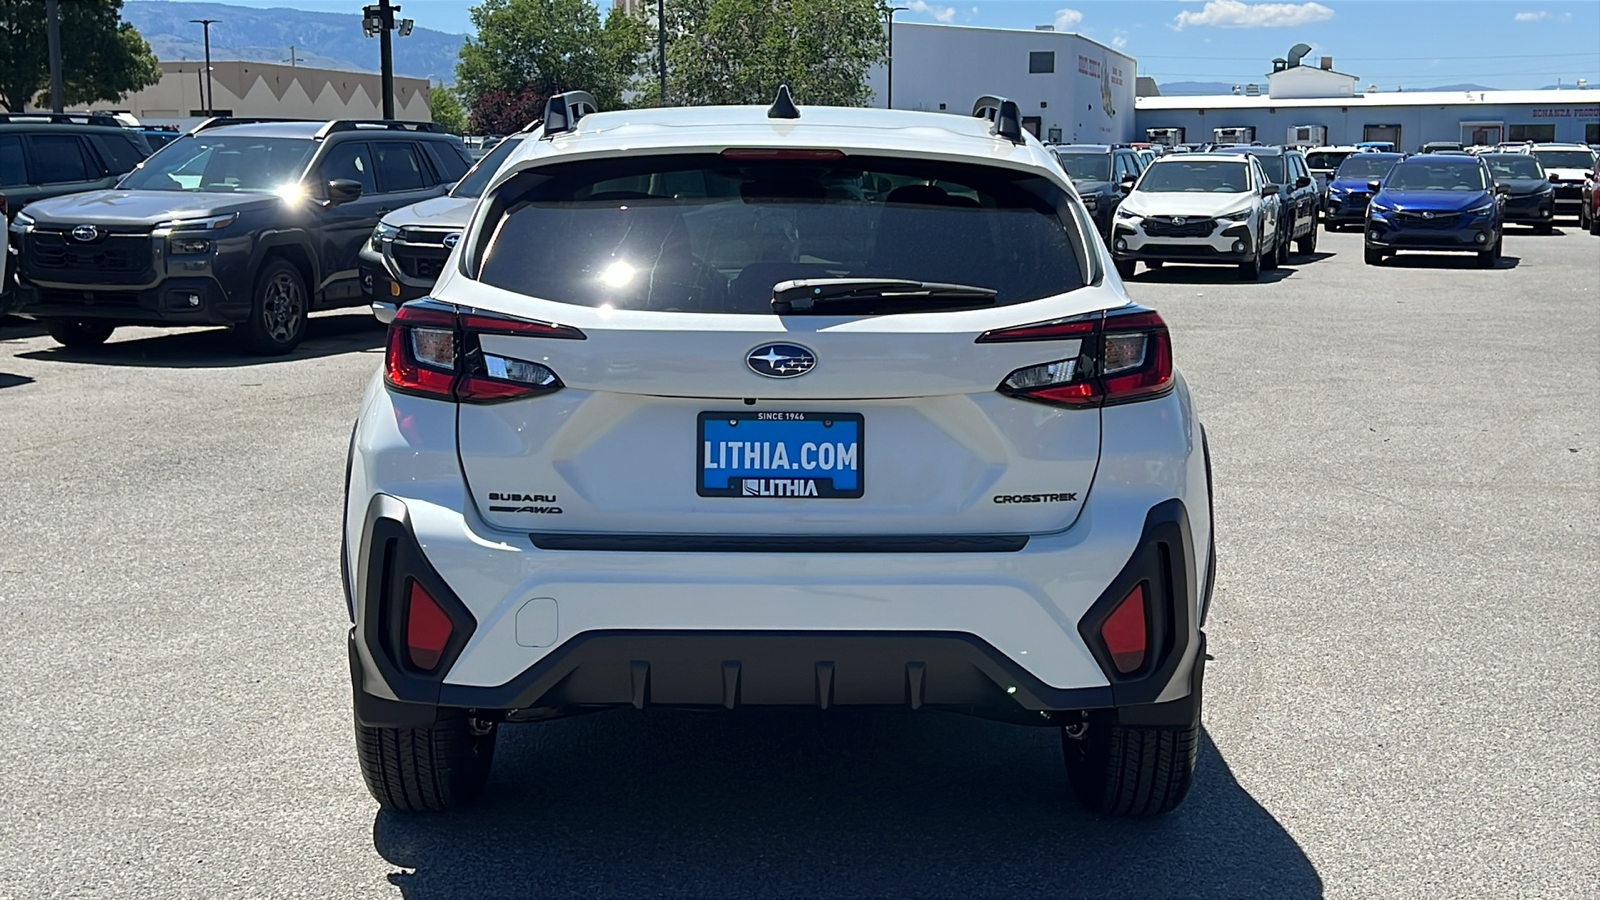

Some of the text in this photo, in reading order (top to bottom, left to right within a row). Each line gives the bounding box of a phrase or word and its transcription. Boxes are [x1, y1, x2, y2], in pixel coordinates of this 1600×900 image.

[1574, 108, 1600, 117] PRODU
[704, 441, 858, 470] LITHIA.COM
[760, 479, 818, 496] LITHIA
[489, 493, 556, 502] SUBARU
[993, 492, 1077, 503] CROSSTREK
[516, 506, 563, 514] AWD
